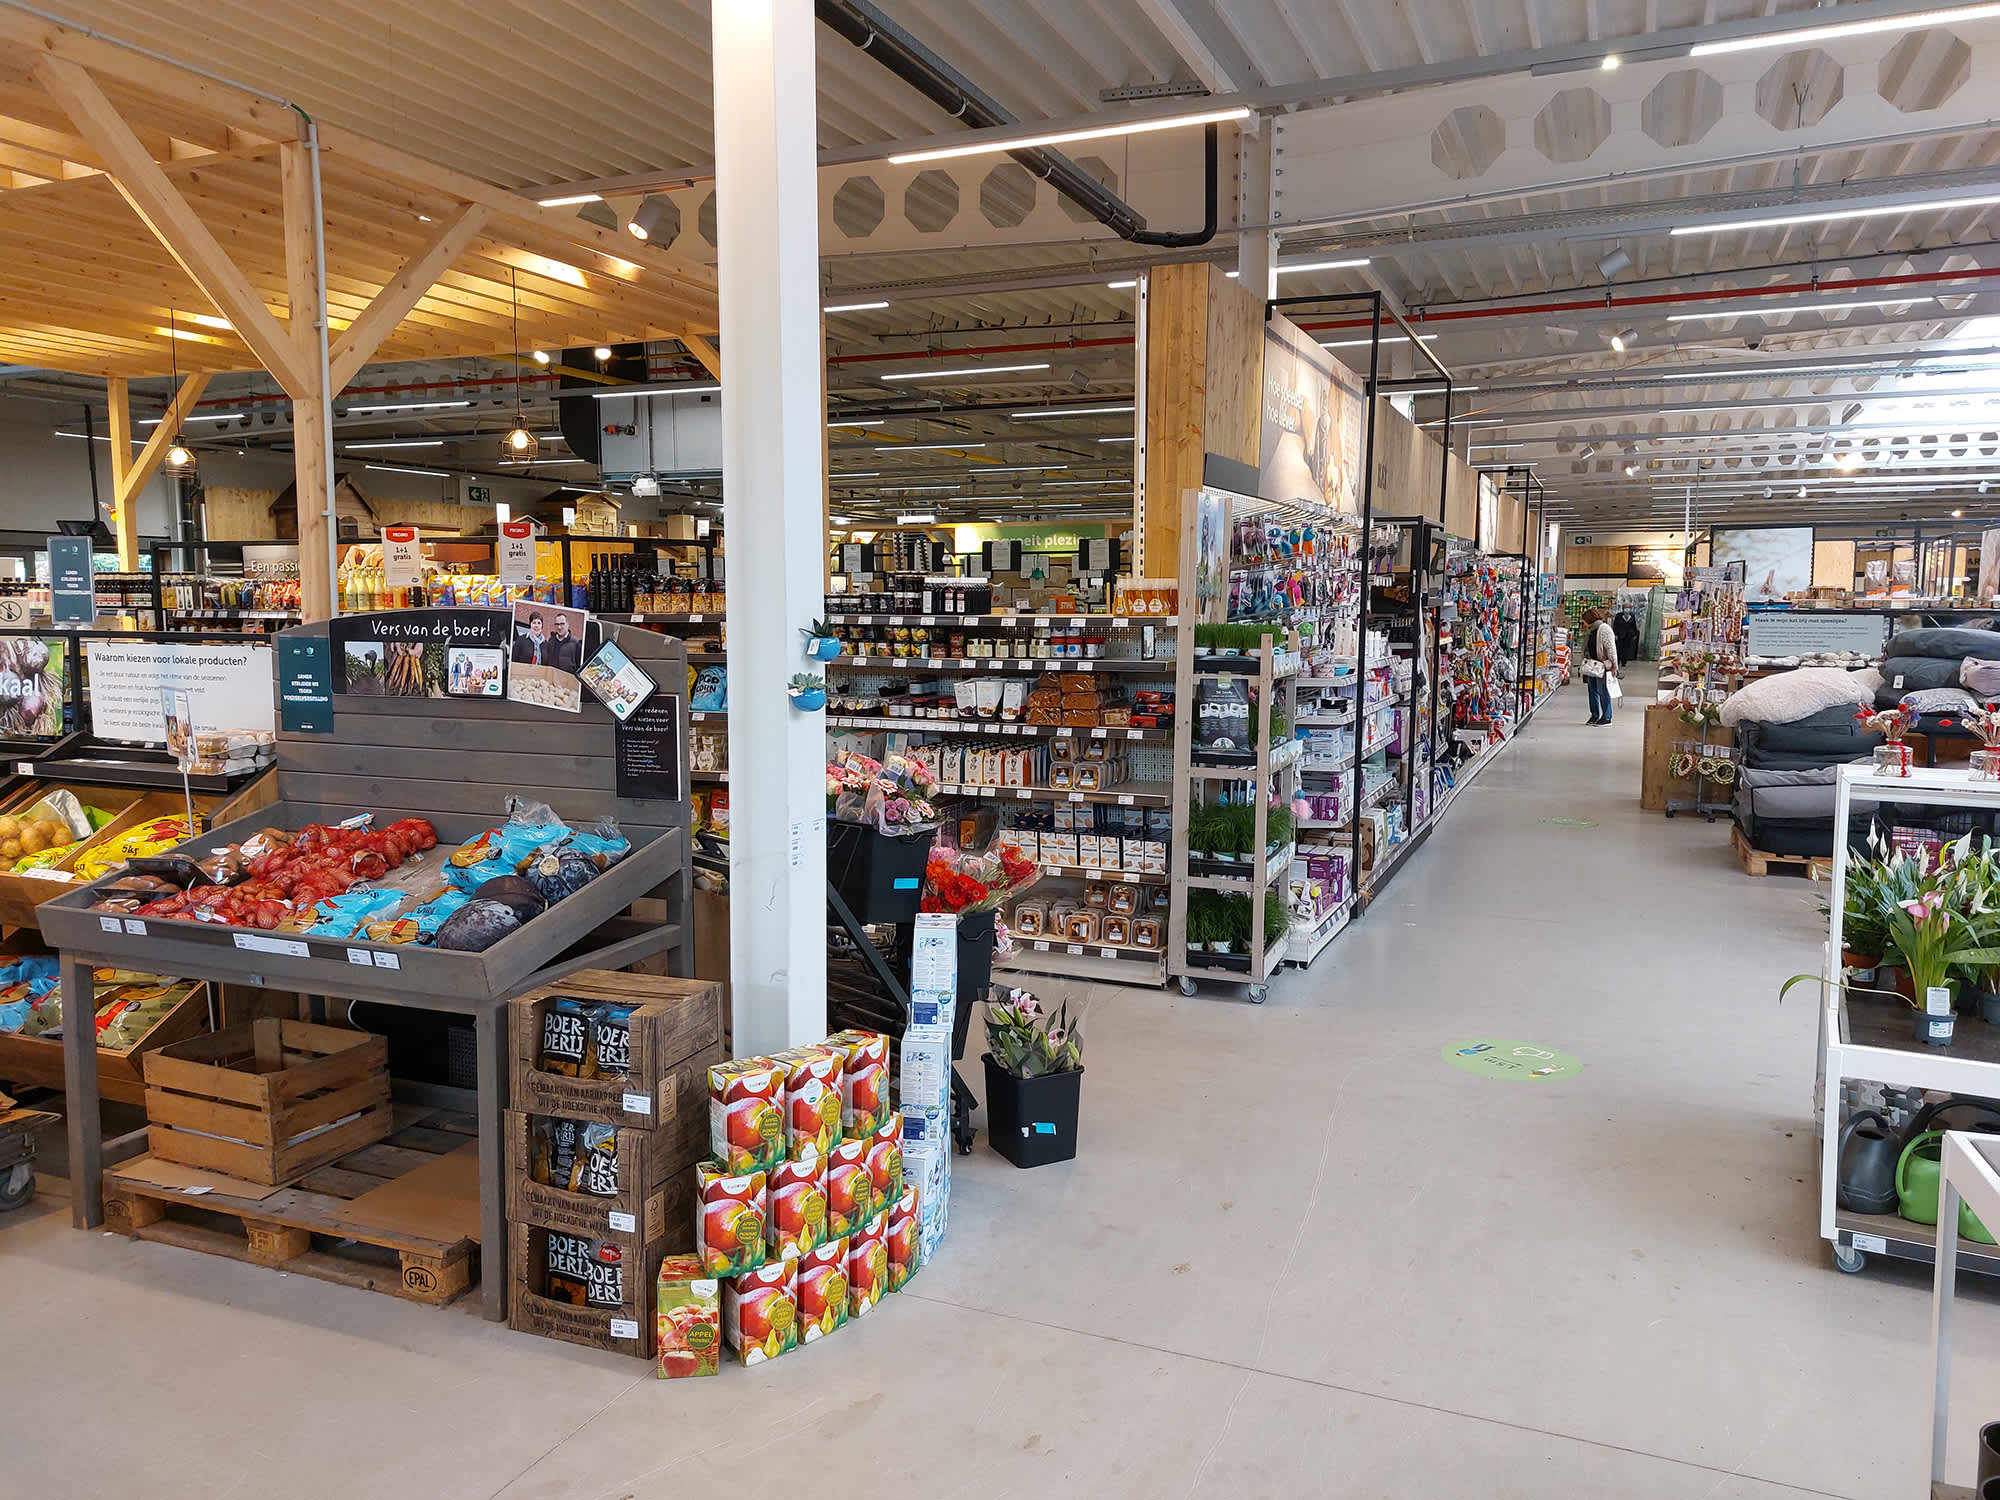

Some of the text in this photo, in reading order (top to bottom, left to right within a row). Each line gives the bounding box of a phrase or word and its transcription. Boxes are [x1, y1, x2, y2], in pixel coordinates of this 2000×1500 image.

[1044, 533, 1091, 548] plezi
[393, 553, 411, 561] gratis
[508, 550, 526, 558] gratis
[251, 560, 300, 574] Een passi
[371, 618, 491, 637] Vers van de boer!
[94, 653, 247, 668] Waarom kiezen voor lokale producten?
[0, 672, 40, 699] kaal
[545, 1013, 585, 1036] BOER-
[548, 1232, 590, 1259] BOER-
[408, 1271, 430, 1288] EPAL
[689, 1330, 713, 1338] APPEL
